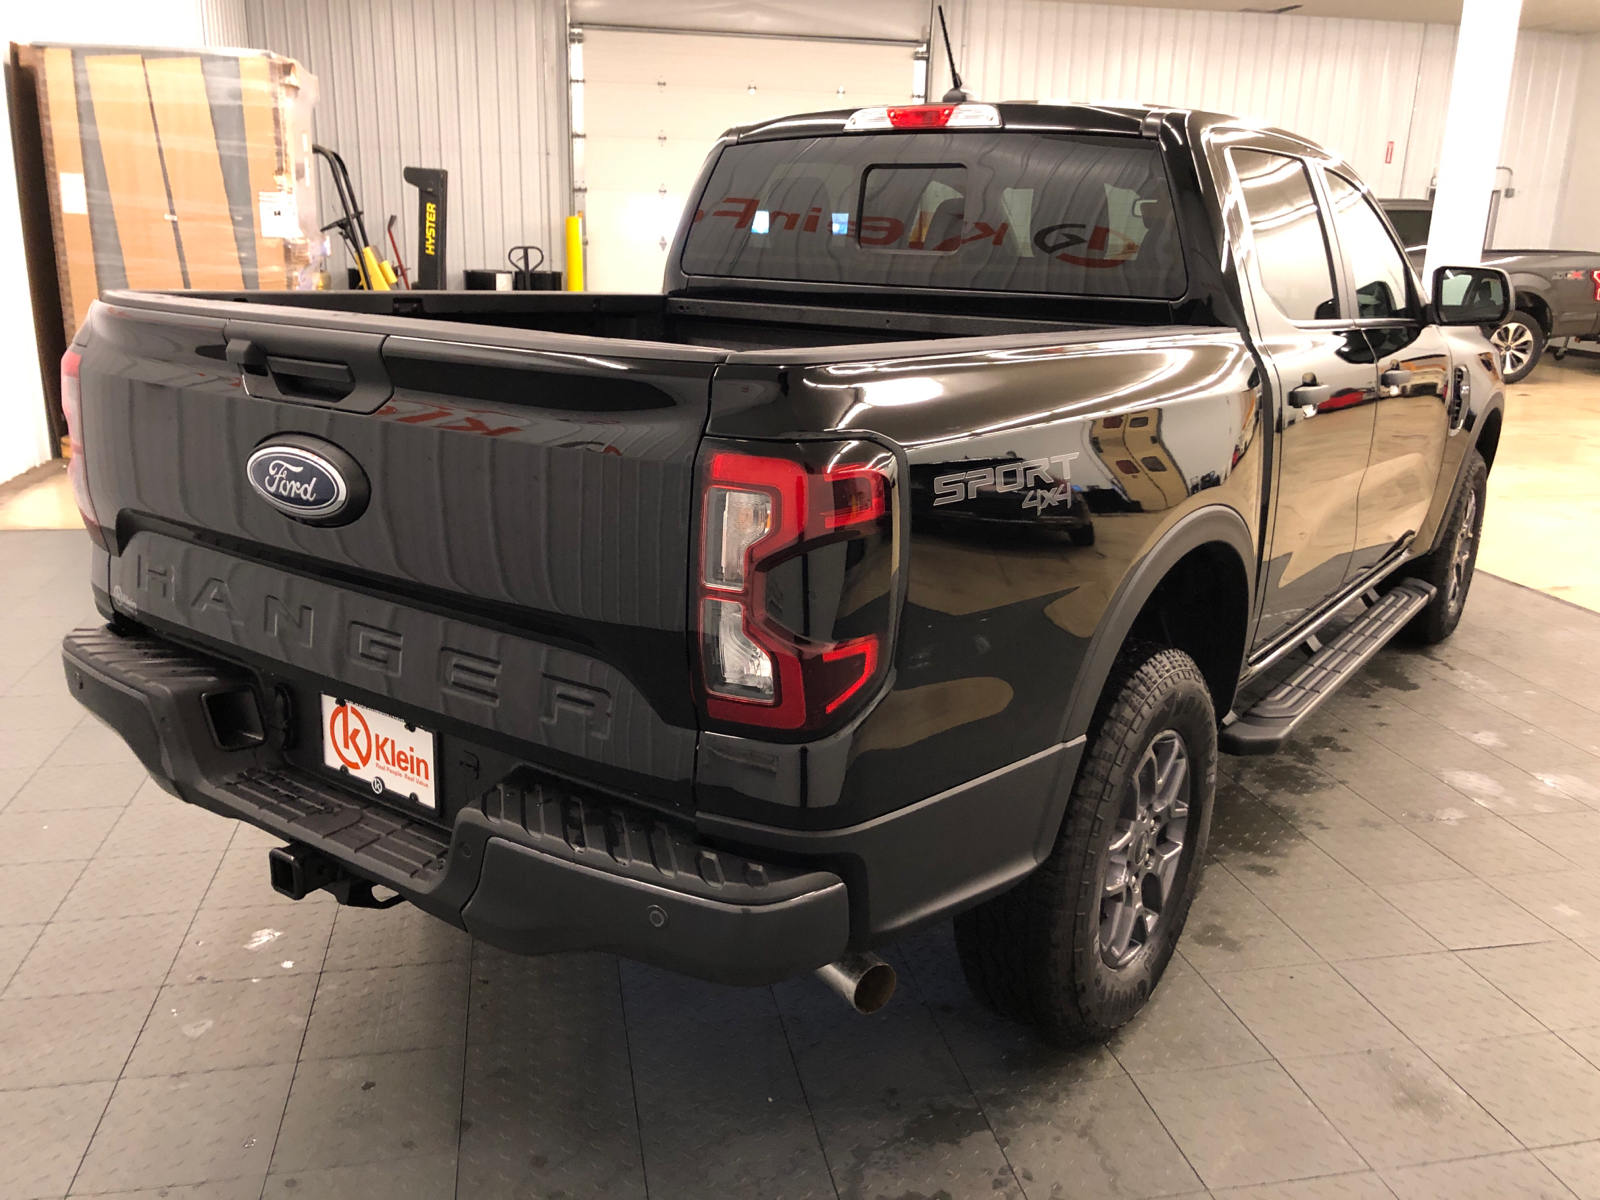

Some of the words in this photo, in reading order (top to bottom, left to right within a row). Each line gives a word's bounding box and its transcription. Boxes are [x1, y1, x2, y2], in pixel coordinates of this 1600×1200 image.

[425, 202, 436, 256] HYSTER
[265, 460, 317, 502] Ford
[933, 452, 1080, 507] SPORT
[375, 733, 430, 781] Klein
[375, 762, 386, 772] Real
[404, 773, 415, 783] Real
